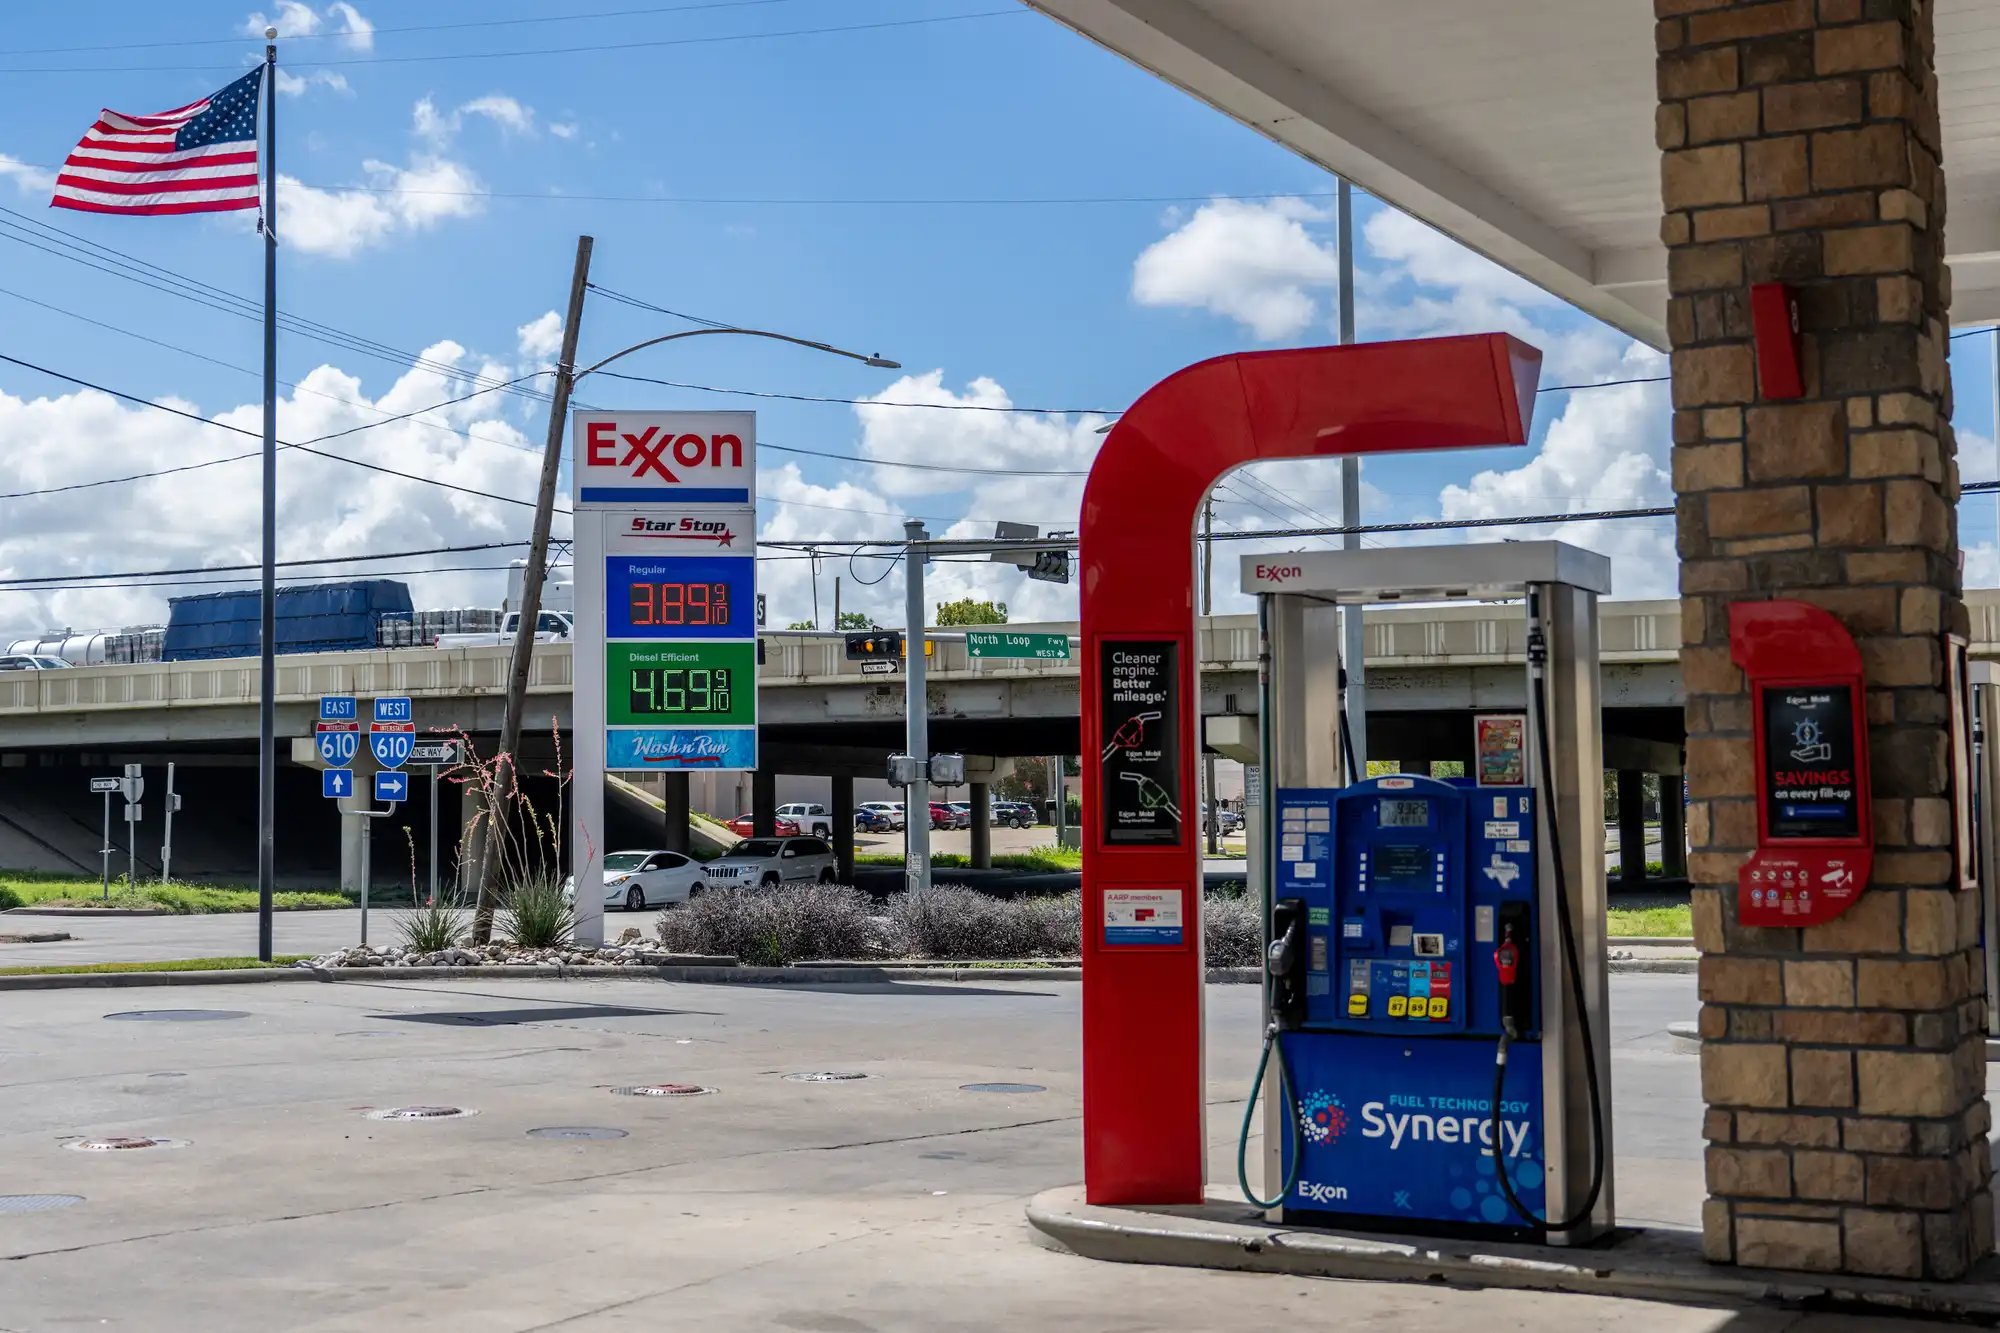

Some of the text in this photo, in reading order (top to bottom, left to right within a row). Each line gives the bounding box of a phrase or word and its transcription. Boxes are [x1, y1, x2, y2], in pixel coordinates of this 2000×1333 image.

[586, 422, 742, 483] Exxon
[631, 517, 726, 535] Star Stop
[629, 564, 667, 576] Regular
[1256, 565, 1302, 583] Exxon
[632, 583, 710, 625] 3.89
[970, 633, 1064, 648] North Loop Fwy
[629, 652, 700, 662] Diesel Efficient
[1035, 649, 1056, 658] WEST
[1112, 651, 1162, 664] Cleaner
[1112, 664, 1159, 679] engine.
[632, 669, 711, 711] 4.69
[1113, 678, 1152, 689] Better
[325, 701, 351, 714] EAST
[379, 702, 406, 716] WEST
[321, 733, 356, 758] 610
[376, 736, 408, 758] 610
[411, 747, 442, 757] ONE WAY
[632, 734, 681, 757] Wash
[693, 735, 731, 756] Run
[1775, 770, 1851, 786] SAVINGS
[1775, 787, 1851, 801] on every fill-up
[1391, 1003, 1404, 1011] 87
[1411, 1003, 1424, 1012] 89
[1431, 1004, 1444, 1013] 93
[1389, 1094, 1425, 1108] FUEL
[1361, 1101, 1530, 1158] Synergy
[1298, 1180, 1348, 1203] Exxon
